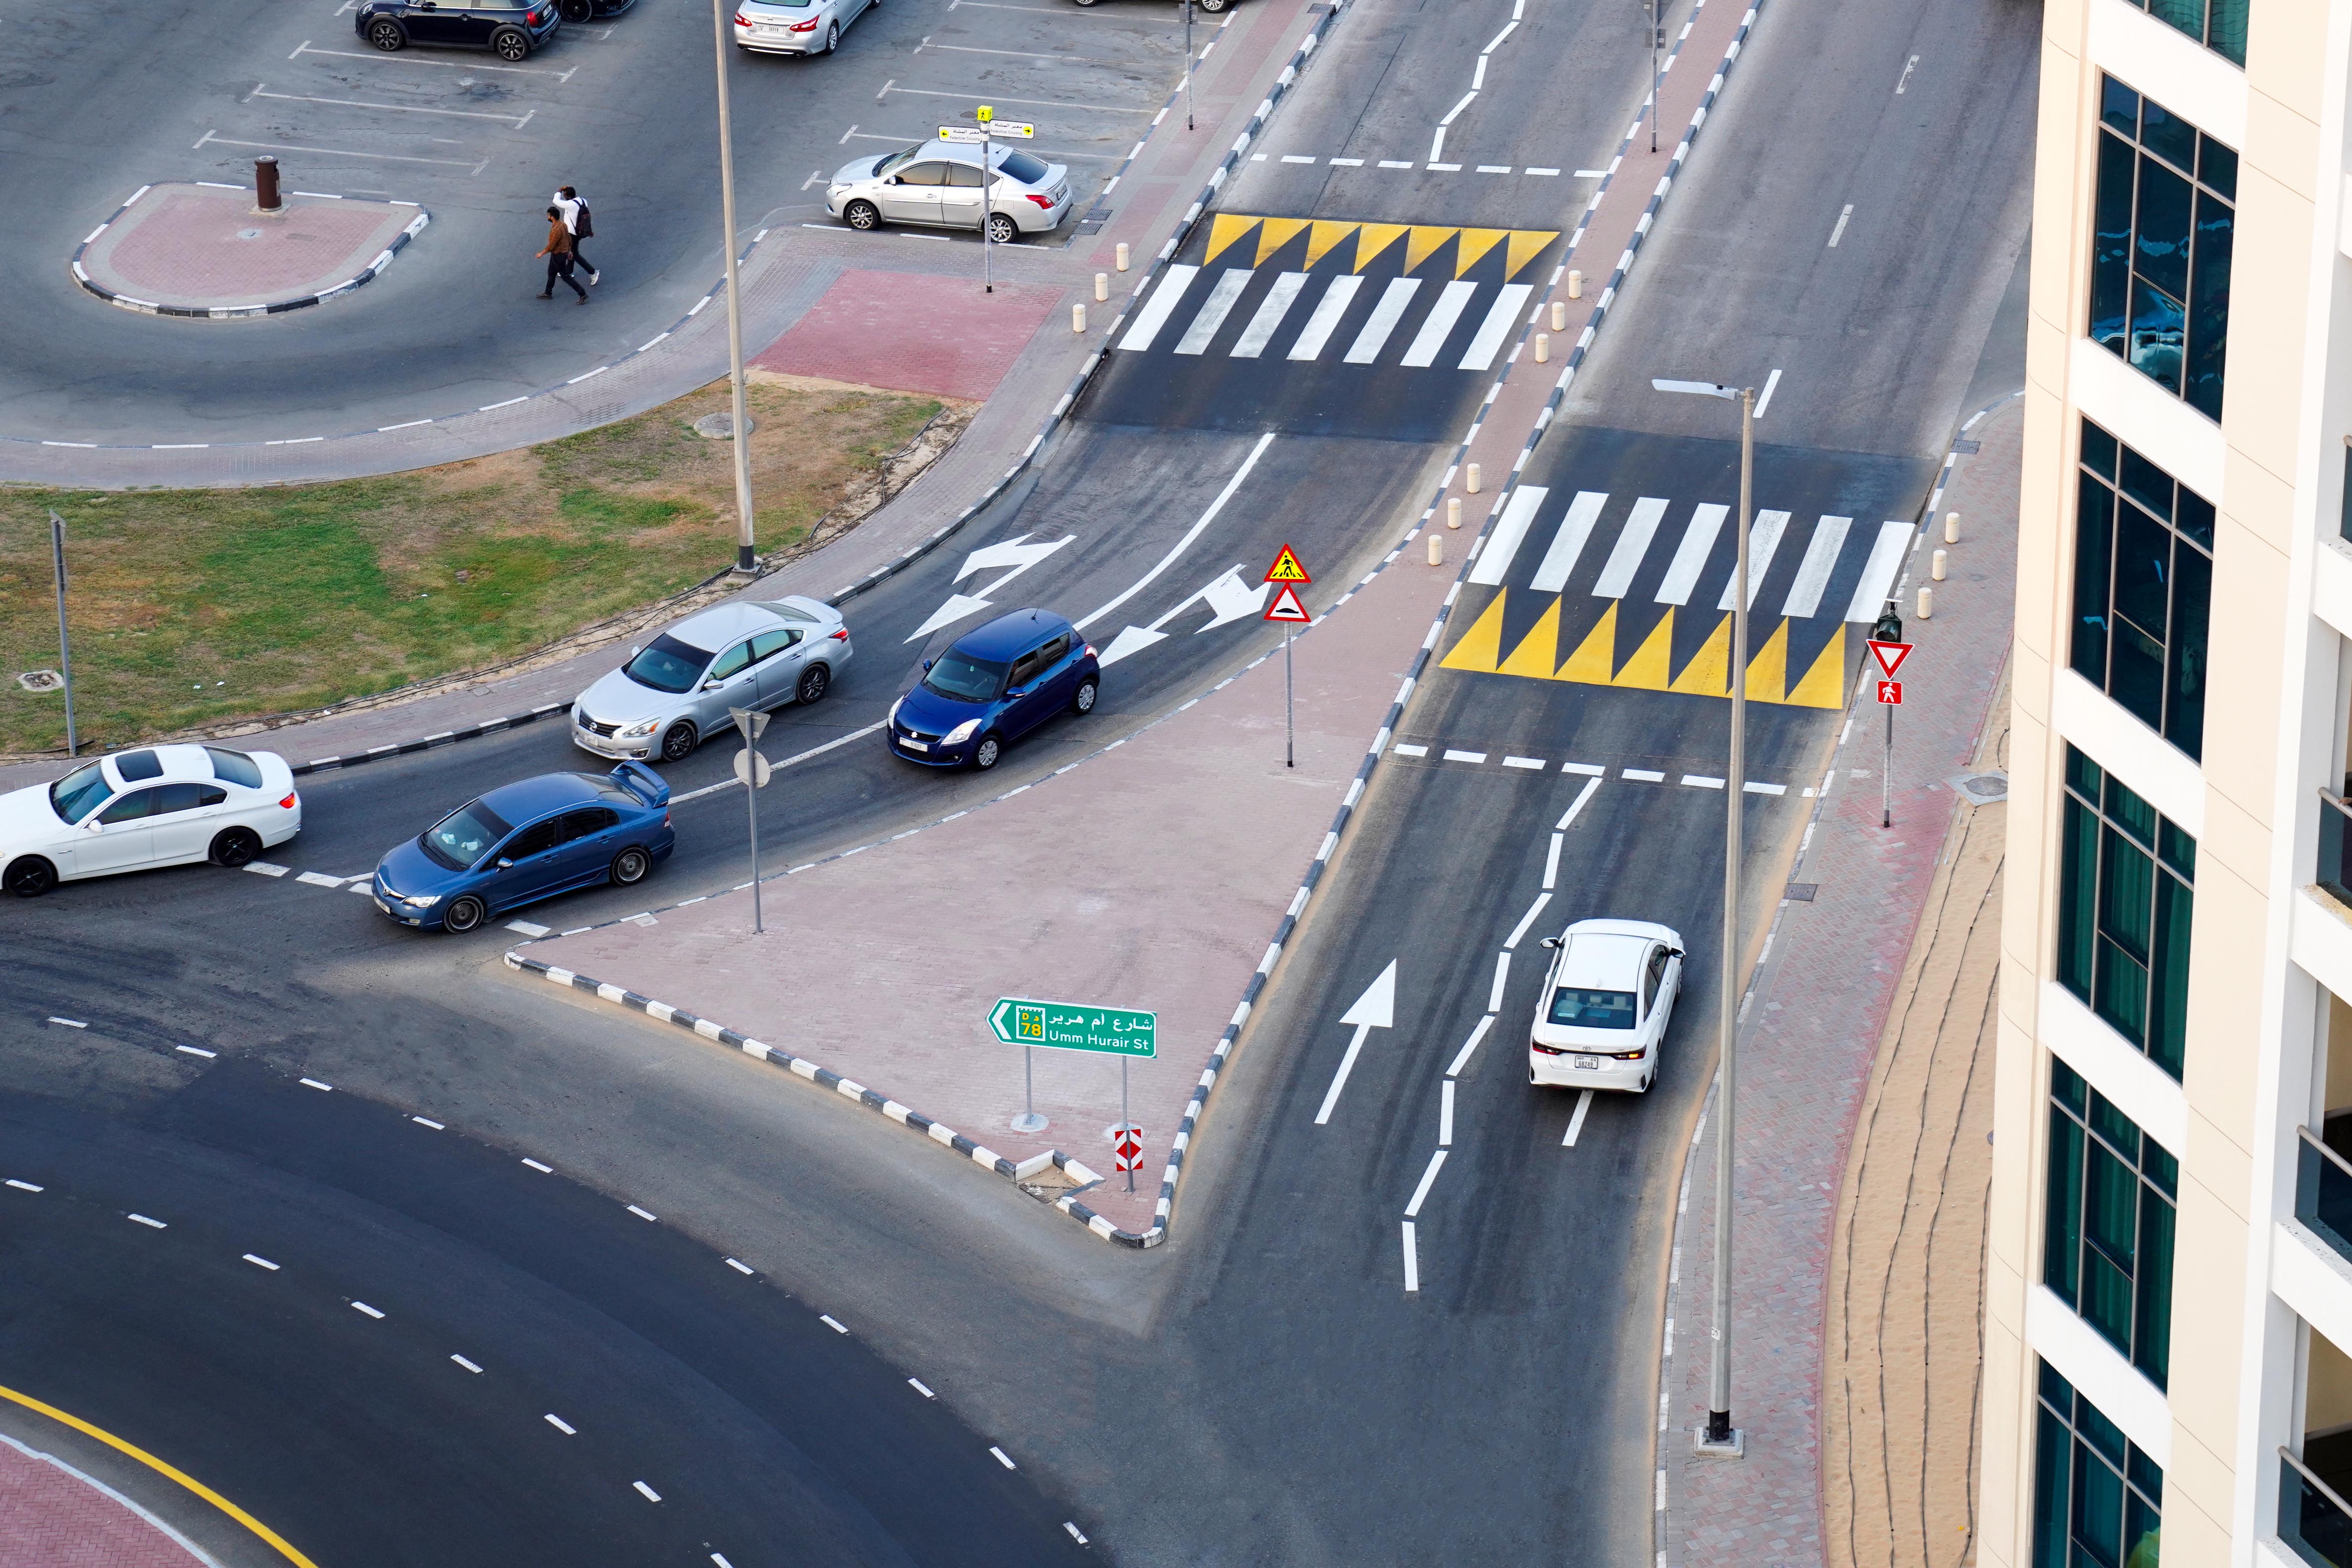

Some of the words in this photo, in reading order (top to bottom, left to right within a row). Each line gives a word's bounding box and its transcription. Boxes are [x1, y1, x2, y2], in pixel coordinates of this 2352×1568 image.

[1048, 1015, 1084, 1025] هرير
[1091, 1012, 1105, 1031] أم
[1113, 1017, 1153, 1032] شارع
[1021, 1023, 1041, 1036] 78
[1049, 1030, 1083, 1043] Umm
[1088, 1034, 1129, 1048] Hurair
[1133, 1038, 1149, 1050] St
